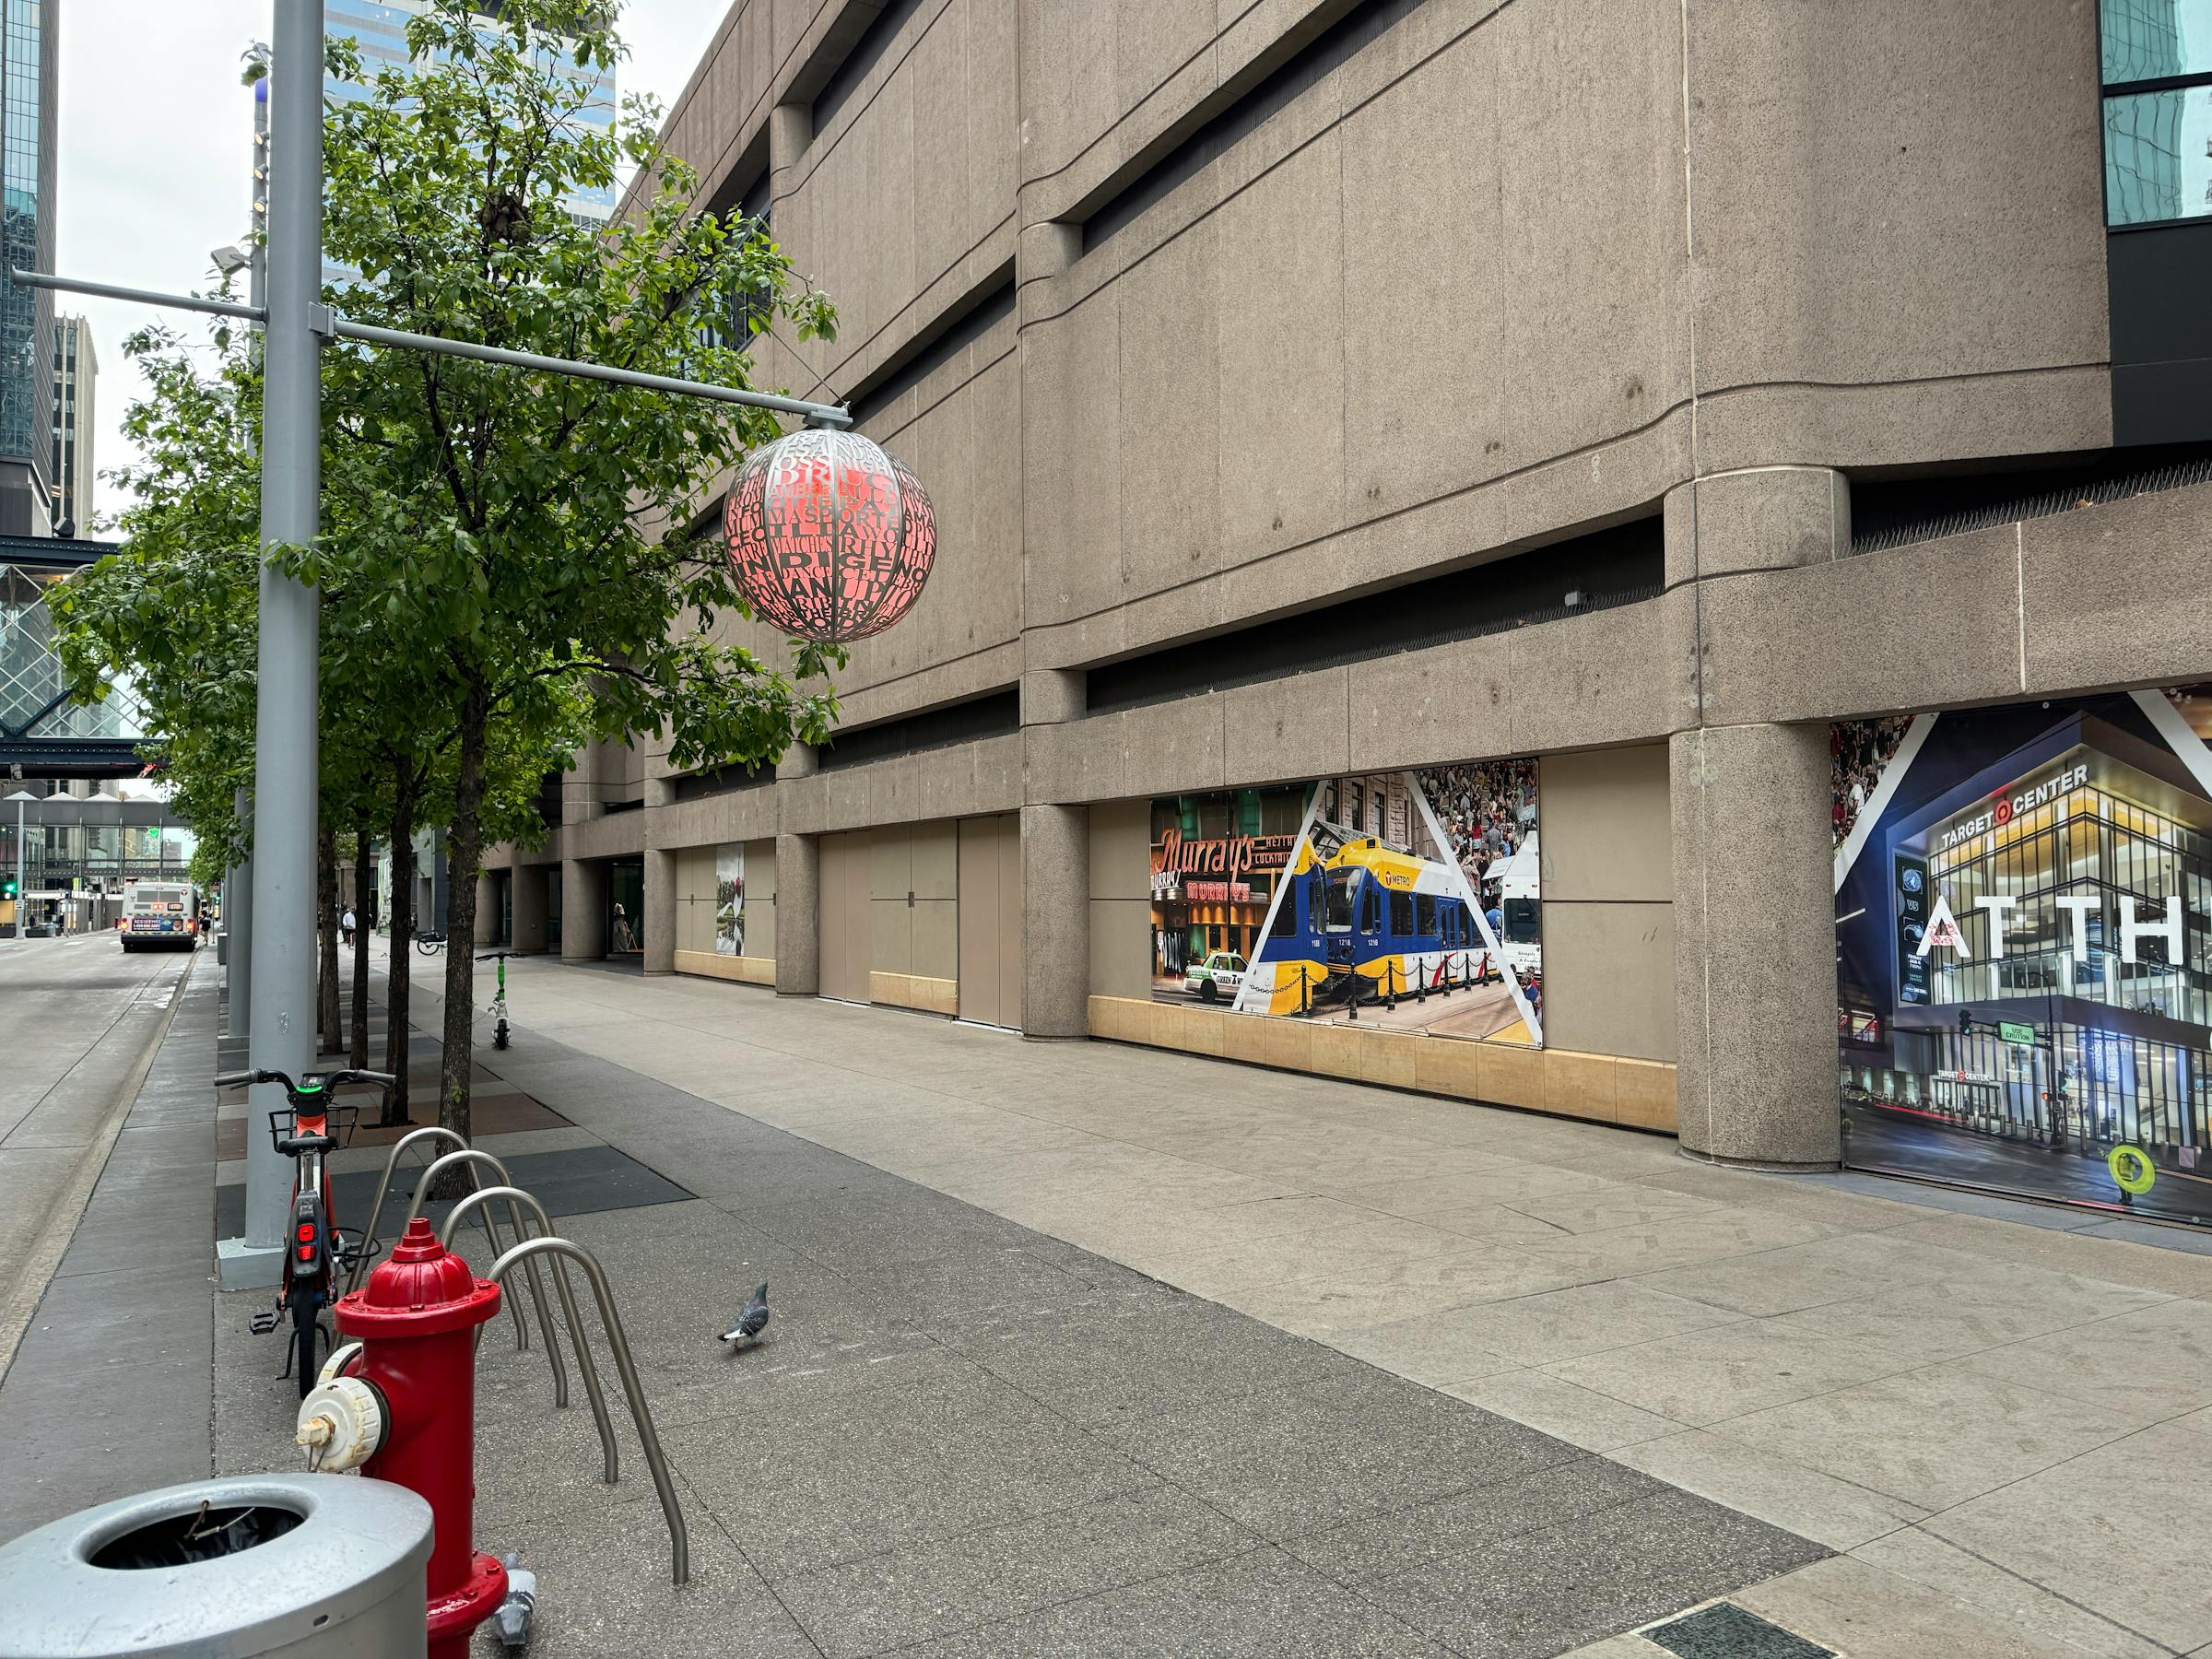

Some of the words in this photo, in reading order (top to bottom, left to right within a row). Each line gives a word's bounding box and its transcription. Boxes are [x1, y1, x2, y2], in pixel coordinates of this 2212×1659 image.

[1942, 811, 1996, 849] TARGET
[2012, 763, 2088, 814] CENTER
[1152, 828, 1254, 884] Murray's
[1392, 875, 1410, 887] METRO
[2055, 895, 2212, 966] TH
[1937, 1070, 1959, 1080] TARGET
